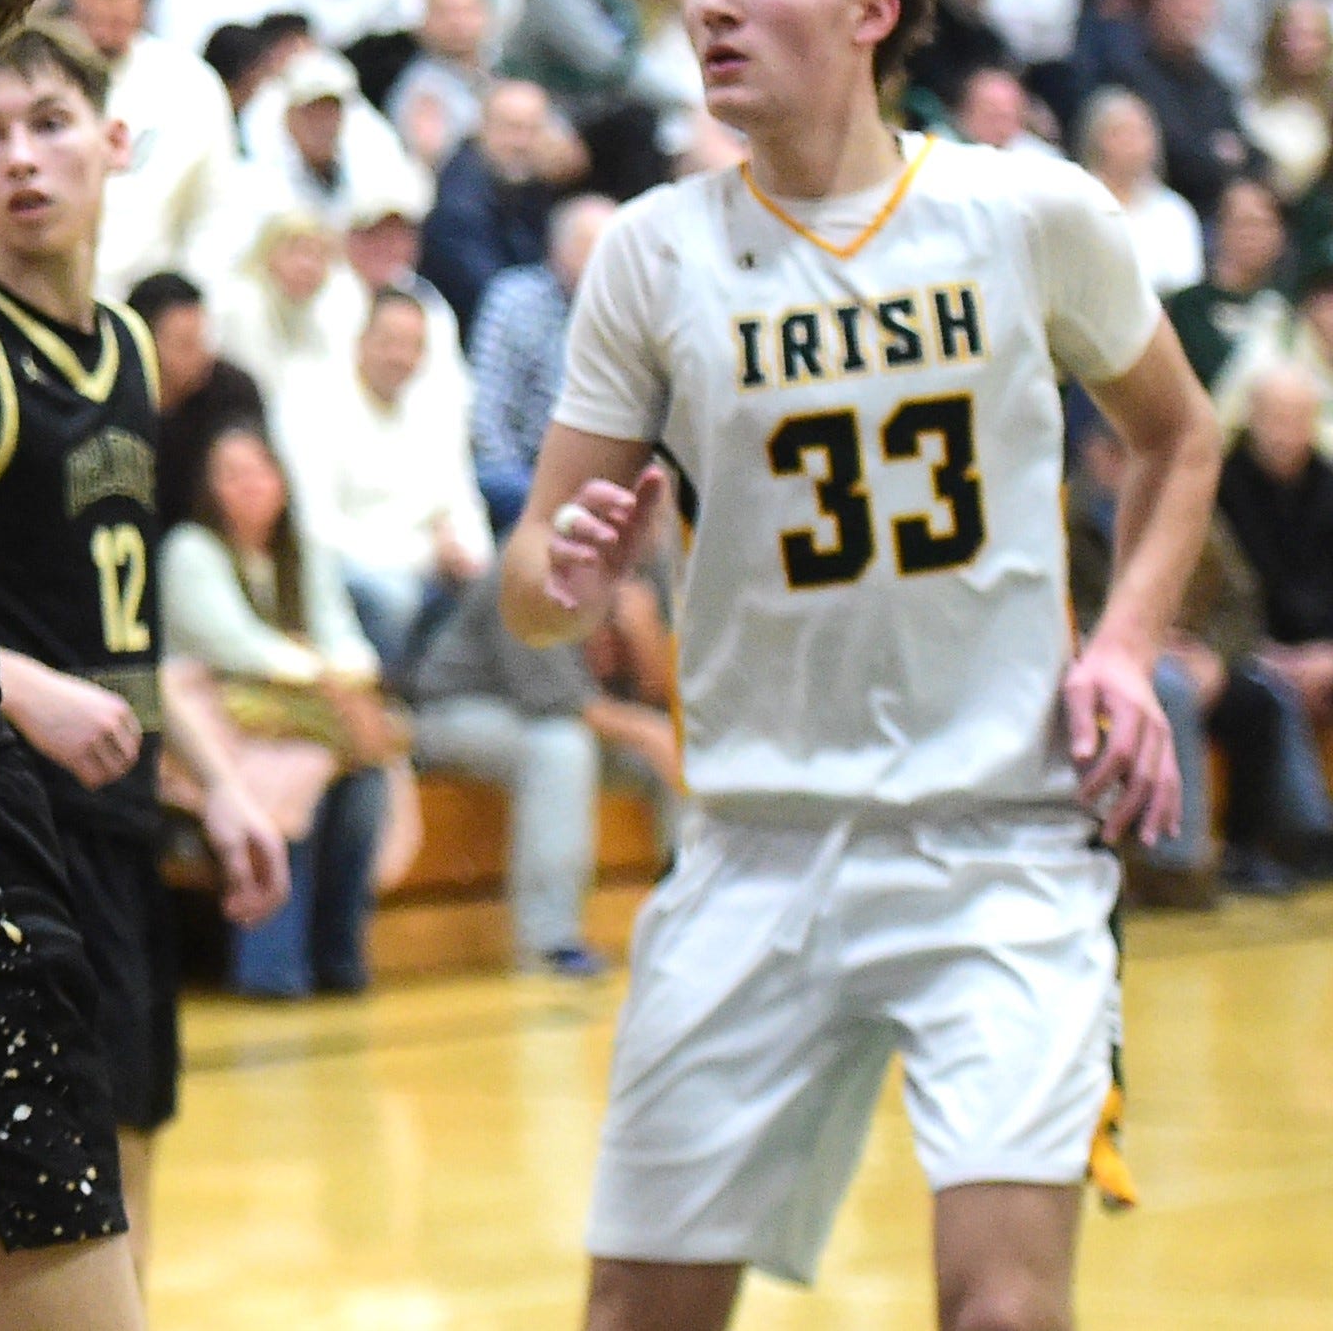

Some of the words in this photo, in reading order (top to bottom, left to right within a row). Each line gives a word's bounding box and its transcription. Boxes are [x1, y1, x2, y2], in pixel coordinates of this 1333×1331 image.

[733, 282, 989, 391] IRISH
[767, 391, 988, 591] 33
[90, 523, 151, 653] 12
